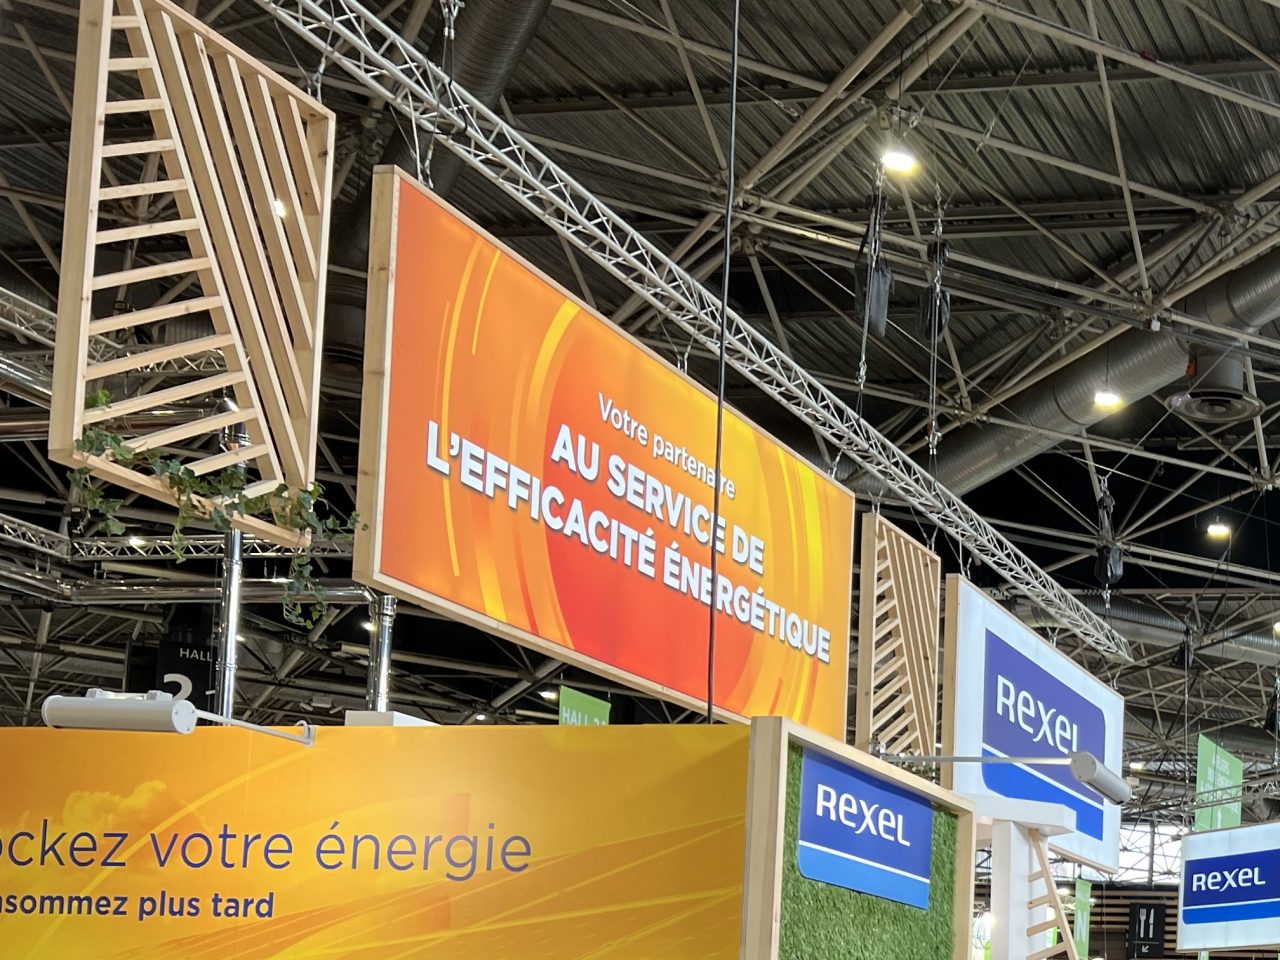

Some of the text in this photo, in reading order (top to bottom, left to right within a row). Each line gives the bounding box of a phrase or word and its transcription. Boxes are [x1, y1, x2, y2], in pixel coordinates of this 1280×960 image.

[598, 392, 736, 500] Votre partenare
[426, 419, 831, 664] L'EFFICACITÉ ÉNERGÉTIQUE
[550, 423, 765, 576] AU SERVICE DE
[180, 647, 213, 663] HALL
[0, 819, 533, 882] ckez votre énergie
[0, 890, 275, 921] sommez plus tard
